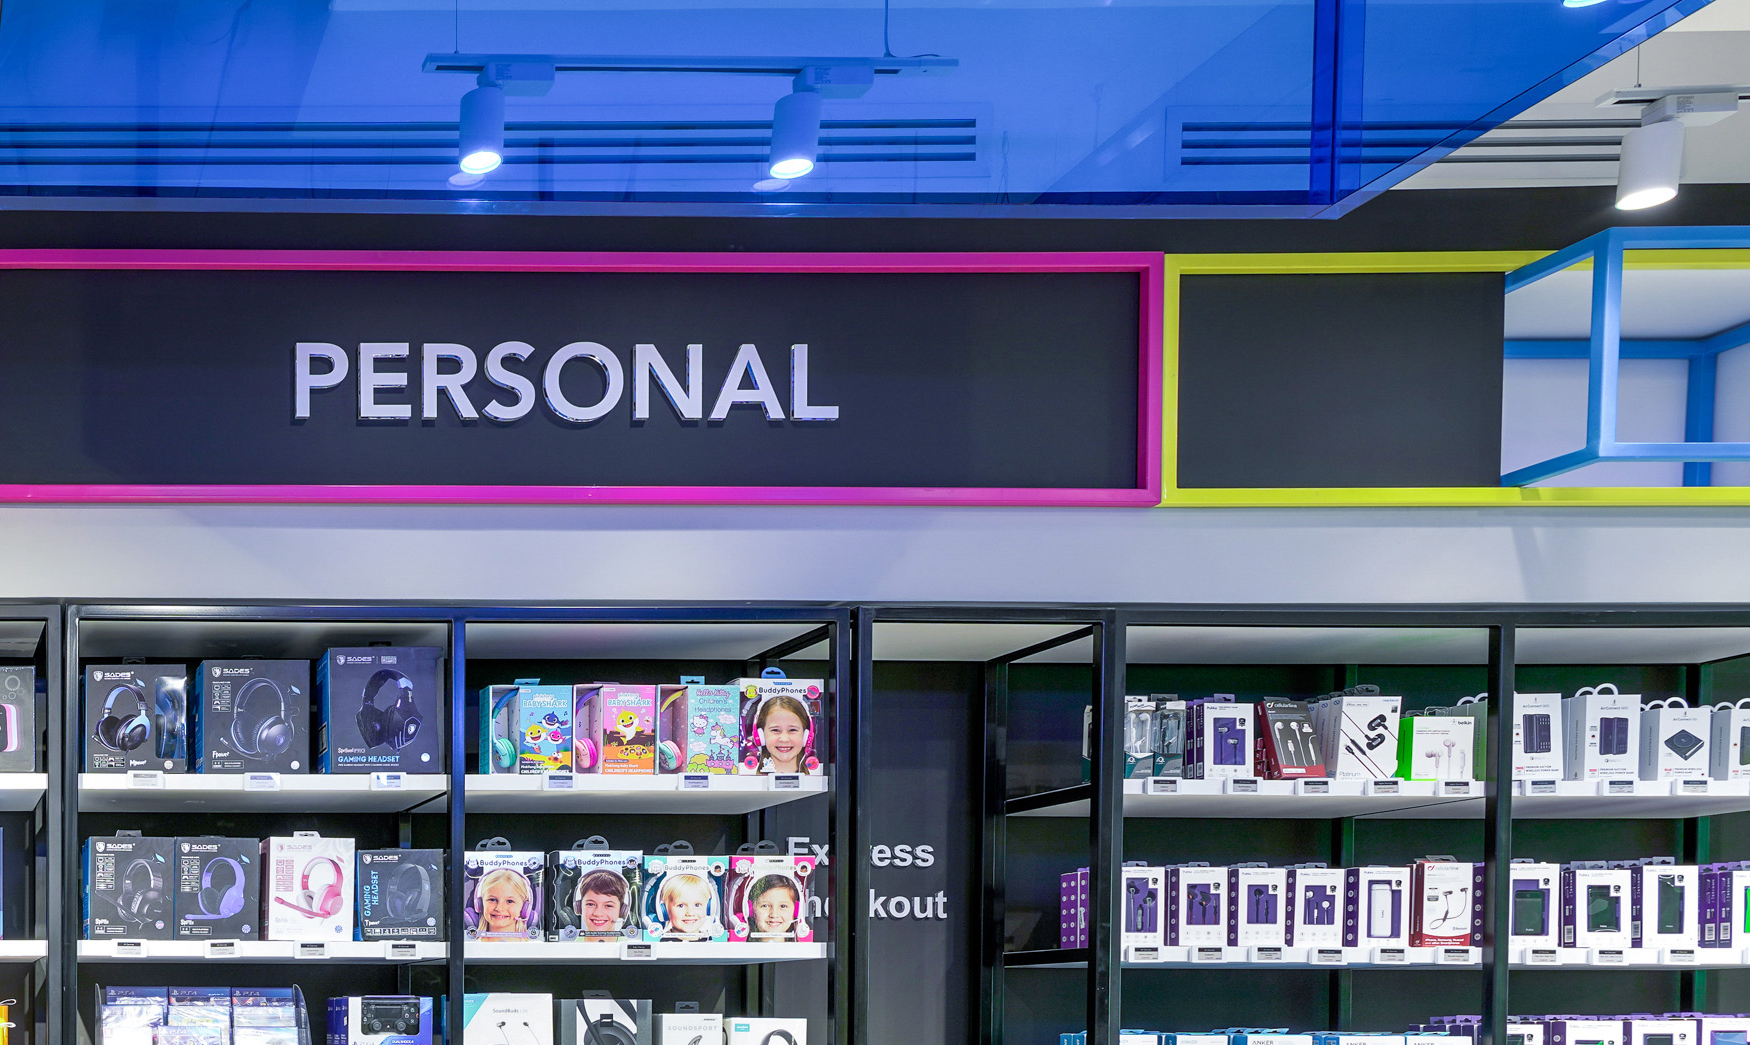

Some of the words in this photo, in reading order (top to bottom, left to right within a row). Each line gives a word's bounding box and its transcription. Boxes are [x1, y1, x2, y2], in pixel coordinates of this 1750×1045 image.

[296, 341, 839, 422] PERSONAL
[758, 687, 807, 695] BuddyPhones
[479, 859, 528, 867] BuddyPhones
[577, 858, 626, 867] BuddyPhones
[787, 837, 934, 867] Exess
[664, 864, 710, 872] BuddyPhones
[363, 885, 371, 917] GAMING
[371, 870, 379, 905] HEADSET
[803, 889, 948, 919] hkout
